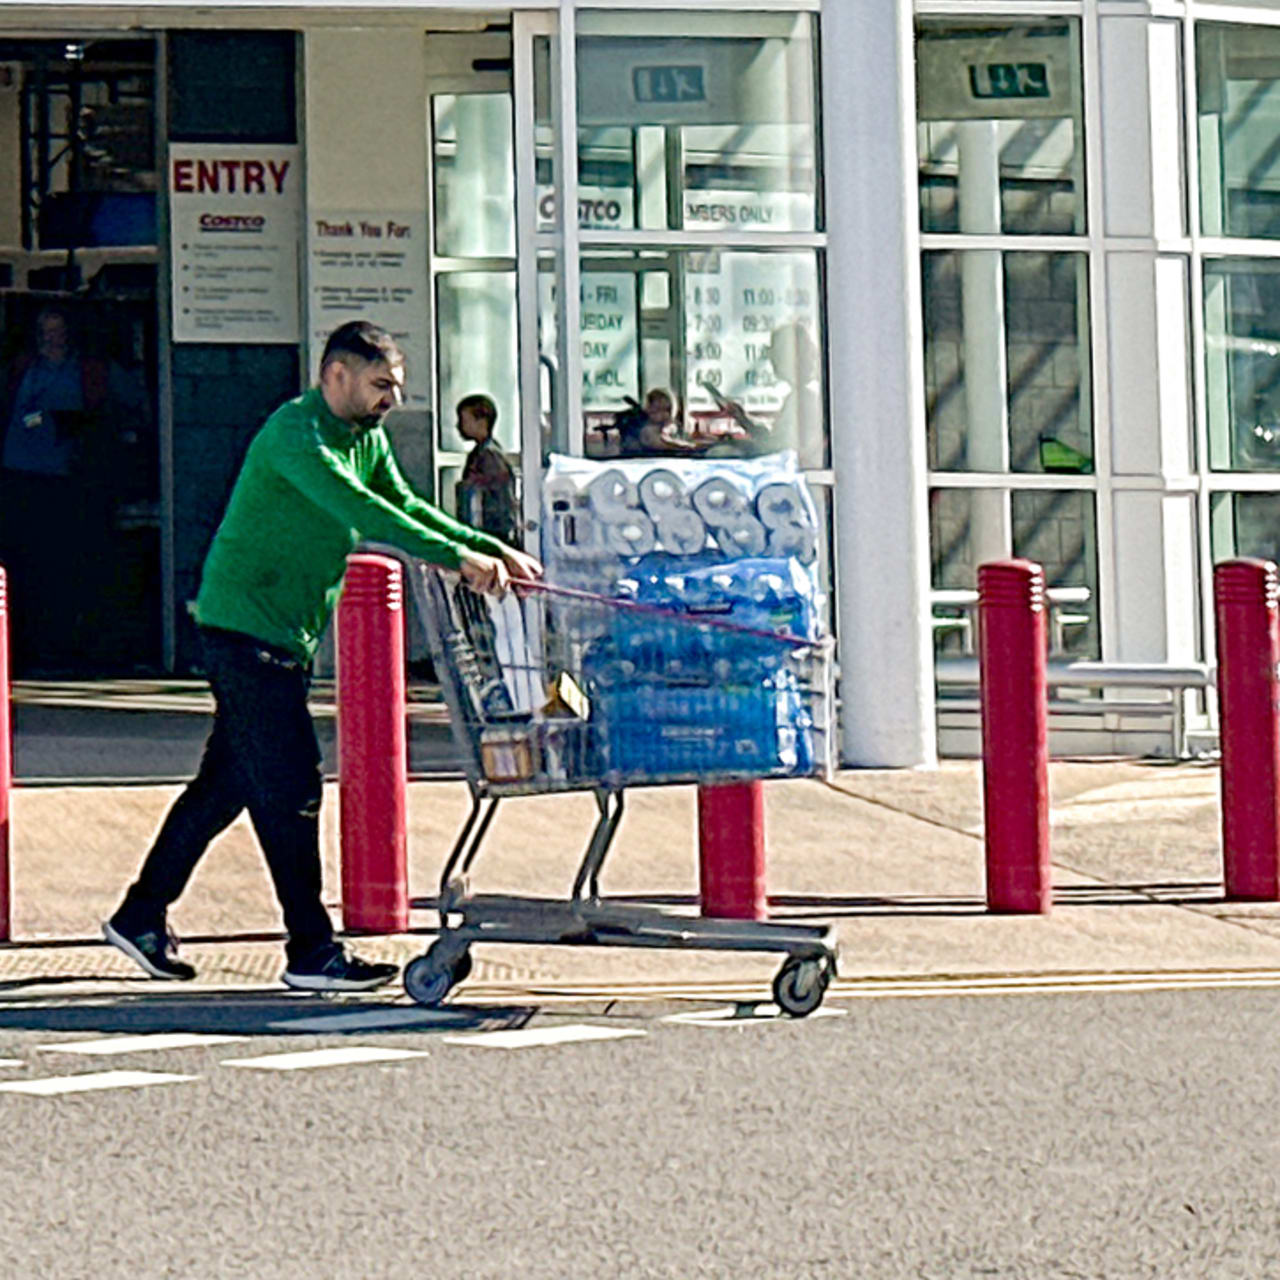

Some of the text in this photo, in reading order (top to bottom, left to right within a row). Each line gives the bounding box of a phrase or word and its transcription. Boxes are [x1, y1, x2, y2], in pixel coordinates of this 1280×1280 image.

[173, 159, 290, 194] ENTRY
[539, 194, 621, 221] CTCO
[739, 205, 774, 224] ONLY
[199, 213, 266, 227] COSTCO
[315, 219, 353, 237] Thank
[357, 220, 382, 238] You
